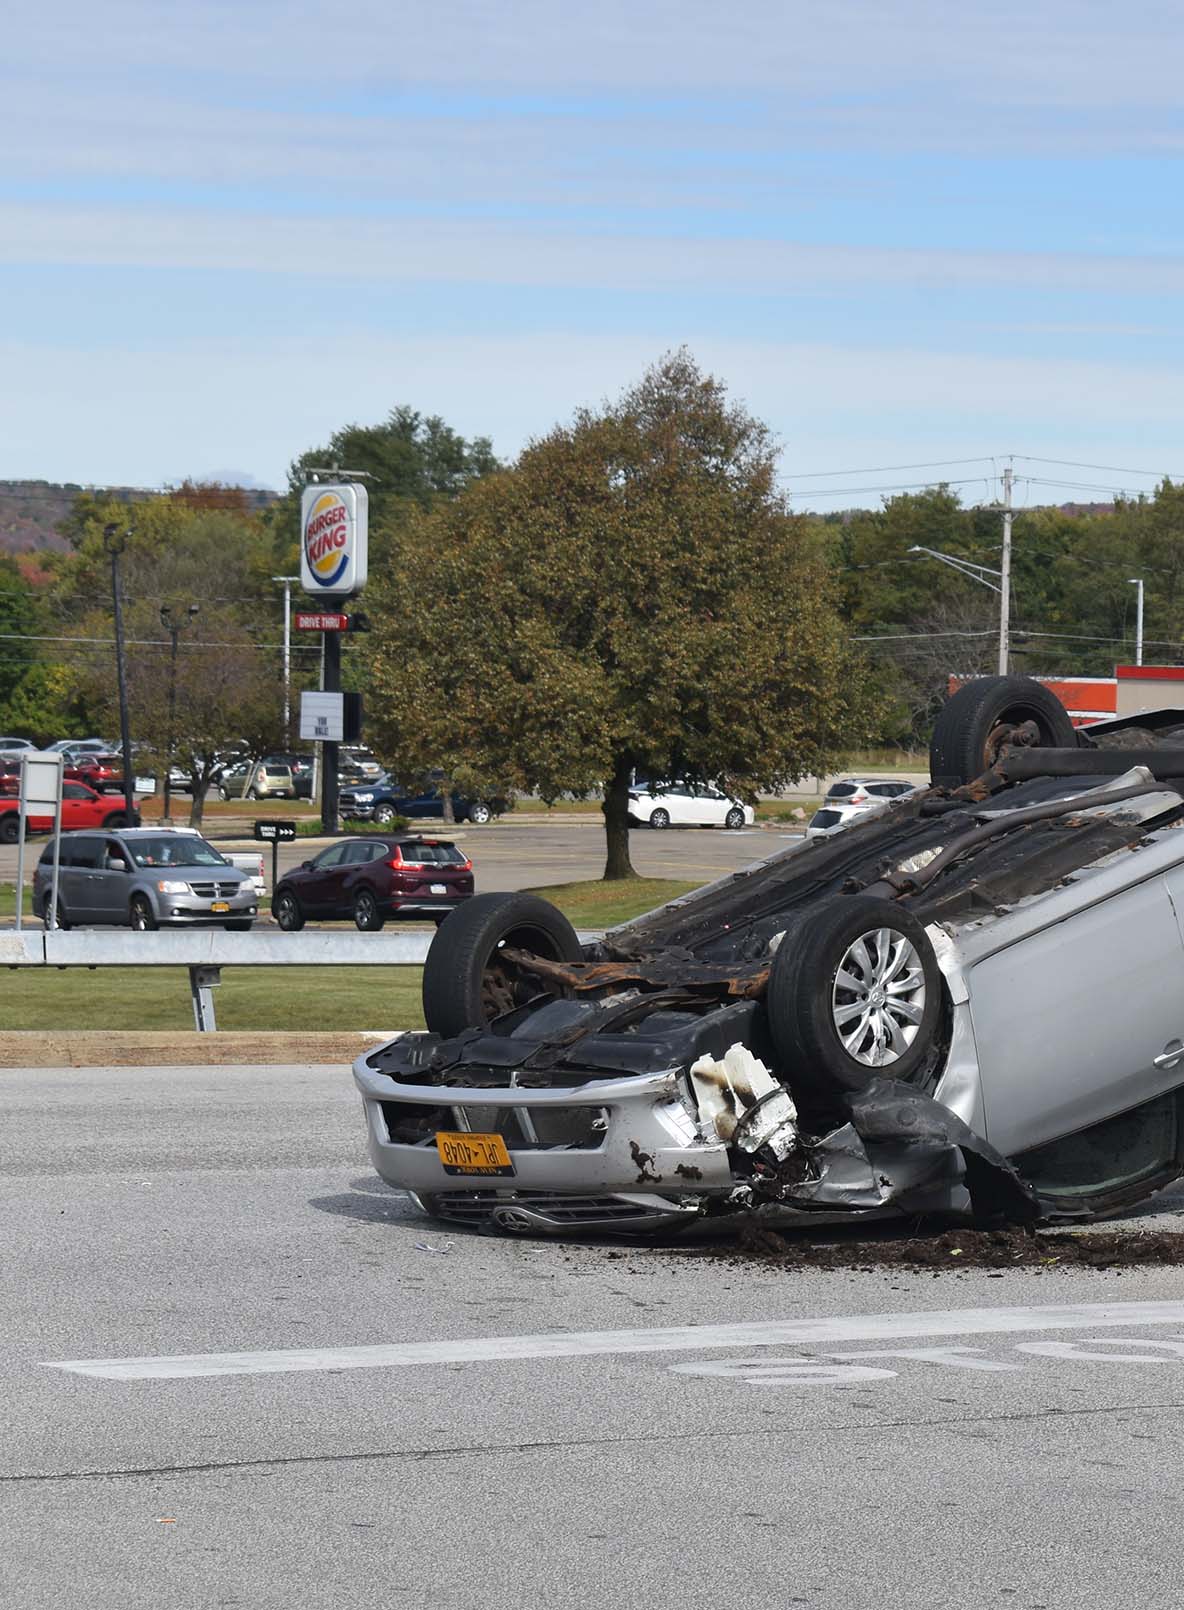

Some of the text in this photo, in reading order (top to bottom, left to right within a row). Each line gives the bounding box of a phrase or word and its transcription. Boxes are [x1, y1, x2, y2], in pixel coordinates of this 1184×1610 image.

[307, 506, 346, 540] BURGER
[308, 525, 346, 562] KING
[299, 614, 340, 628] DRIVE THRU
